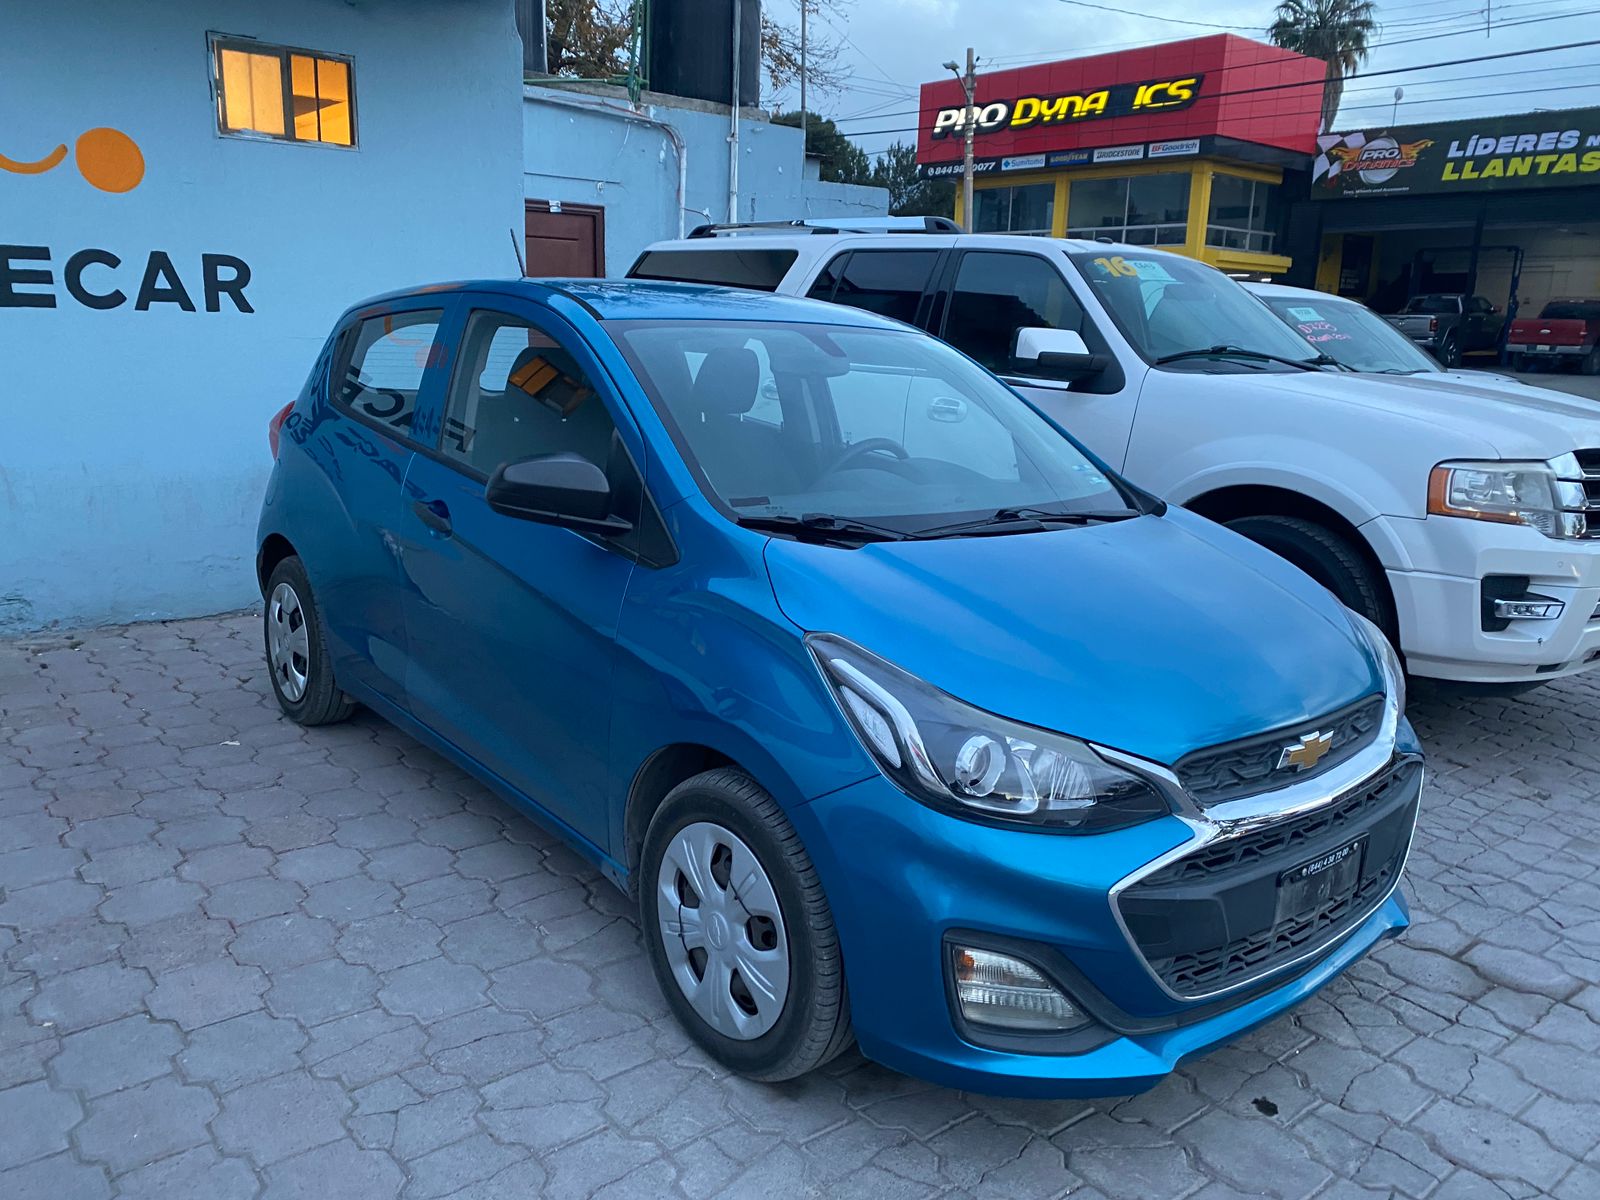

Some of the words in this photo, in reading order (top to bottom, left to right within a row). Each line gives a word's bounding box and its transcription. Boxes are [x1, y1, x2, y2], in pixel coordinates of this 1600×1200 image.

[933, 103, 1009, 133] PRO
[1151, 142, 1197, 153] BFGoodrich
[1447, 130, 1580, 158] LÍDERES
[1096, 148, 1141, 159] BRIDGESTONE
[1361, 148, 1399, 160] PRO
[1011, 158, 1043, 167] Sumitomo
[1342, 158, 1416, 172] DYNAMICS
[1441, 151, 1600, 181] LLANTAS
[1094, 256, 1137, 278] 16
